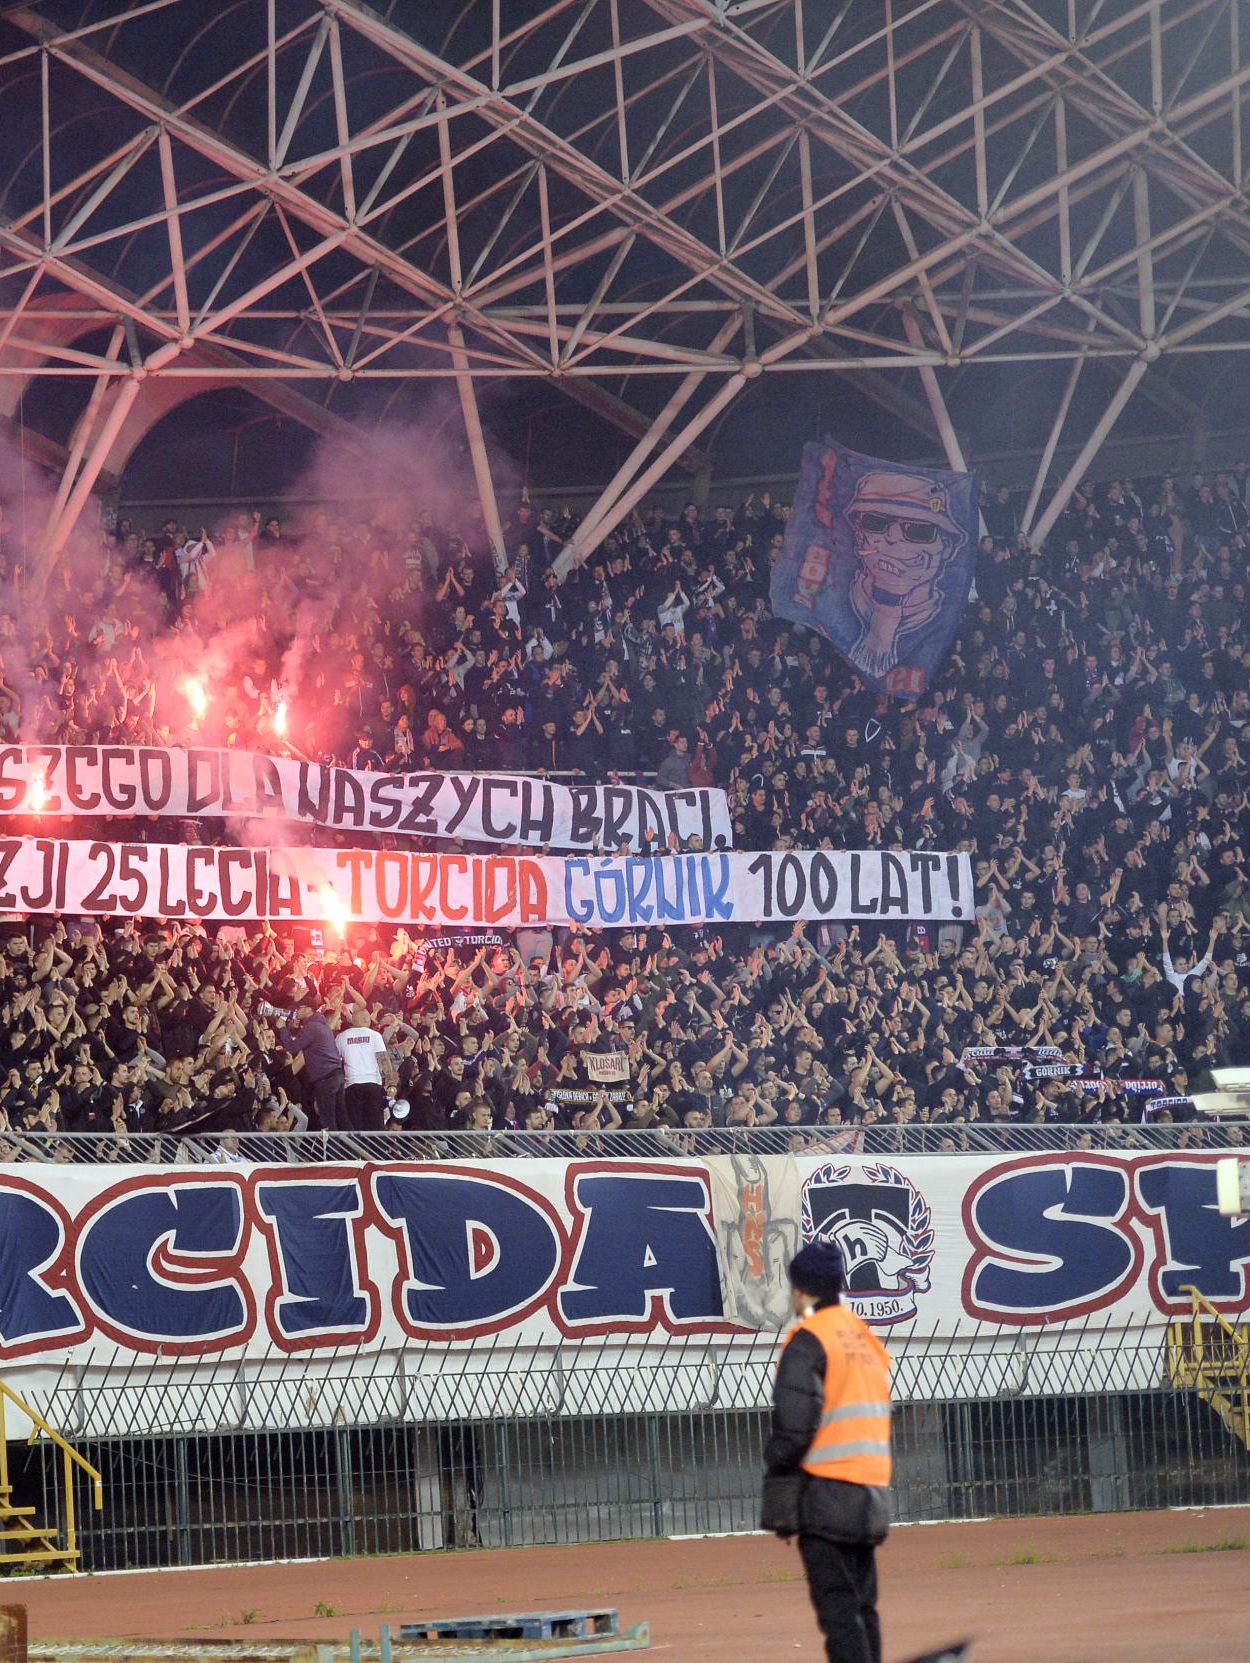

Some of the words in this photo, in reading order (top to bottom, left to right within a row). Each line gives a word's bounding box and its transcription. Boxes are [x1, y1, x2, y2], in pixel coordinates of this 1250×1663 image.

[187, 750, 286, 815] DLA
[298, 761, 555, 842] NASZYCH
[336, 850, 548, 924] TORCIDA
[565, 853, 735, 924] GÓRNIK
[750, 852, 838, 917] 100
[852, 850, 963, 919] LAT!
[463, 935, 503, 945] TORCID
